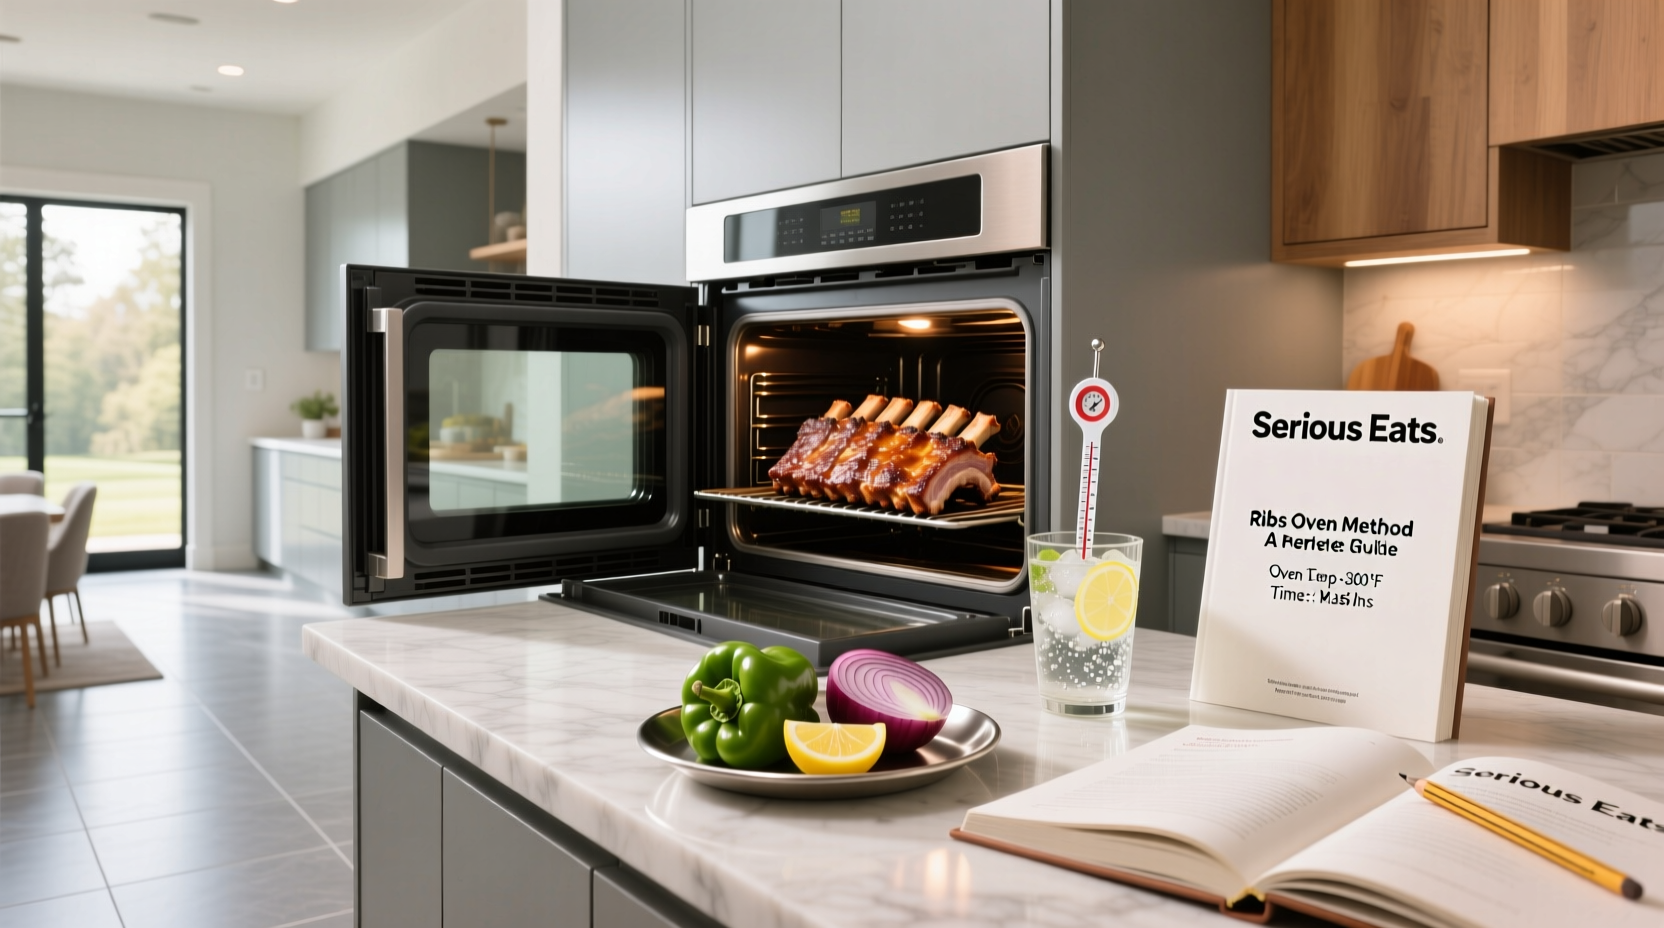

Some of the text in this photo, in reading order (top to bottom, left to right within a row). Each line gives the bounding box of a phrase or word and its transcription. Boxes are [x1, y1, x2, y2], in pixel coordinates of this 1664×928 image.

[1252, 410, 1362, 441] Serious
[1250, 510, 1414, 537] Ribs Oven Method
[1264, 532, 1277, 548] A
[1269, 564, 1303, 581] Oven
[1449, 767, 1583, 804] Serious
